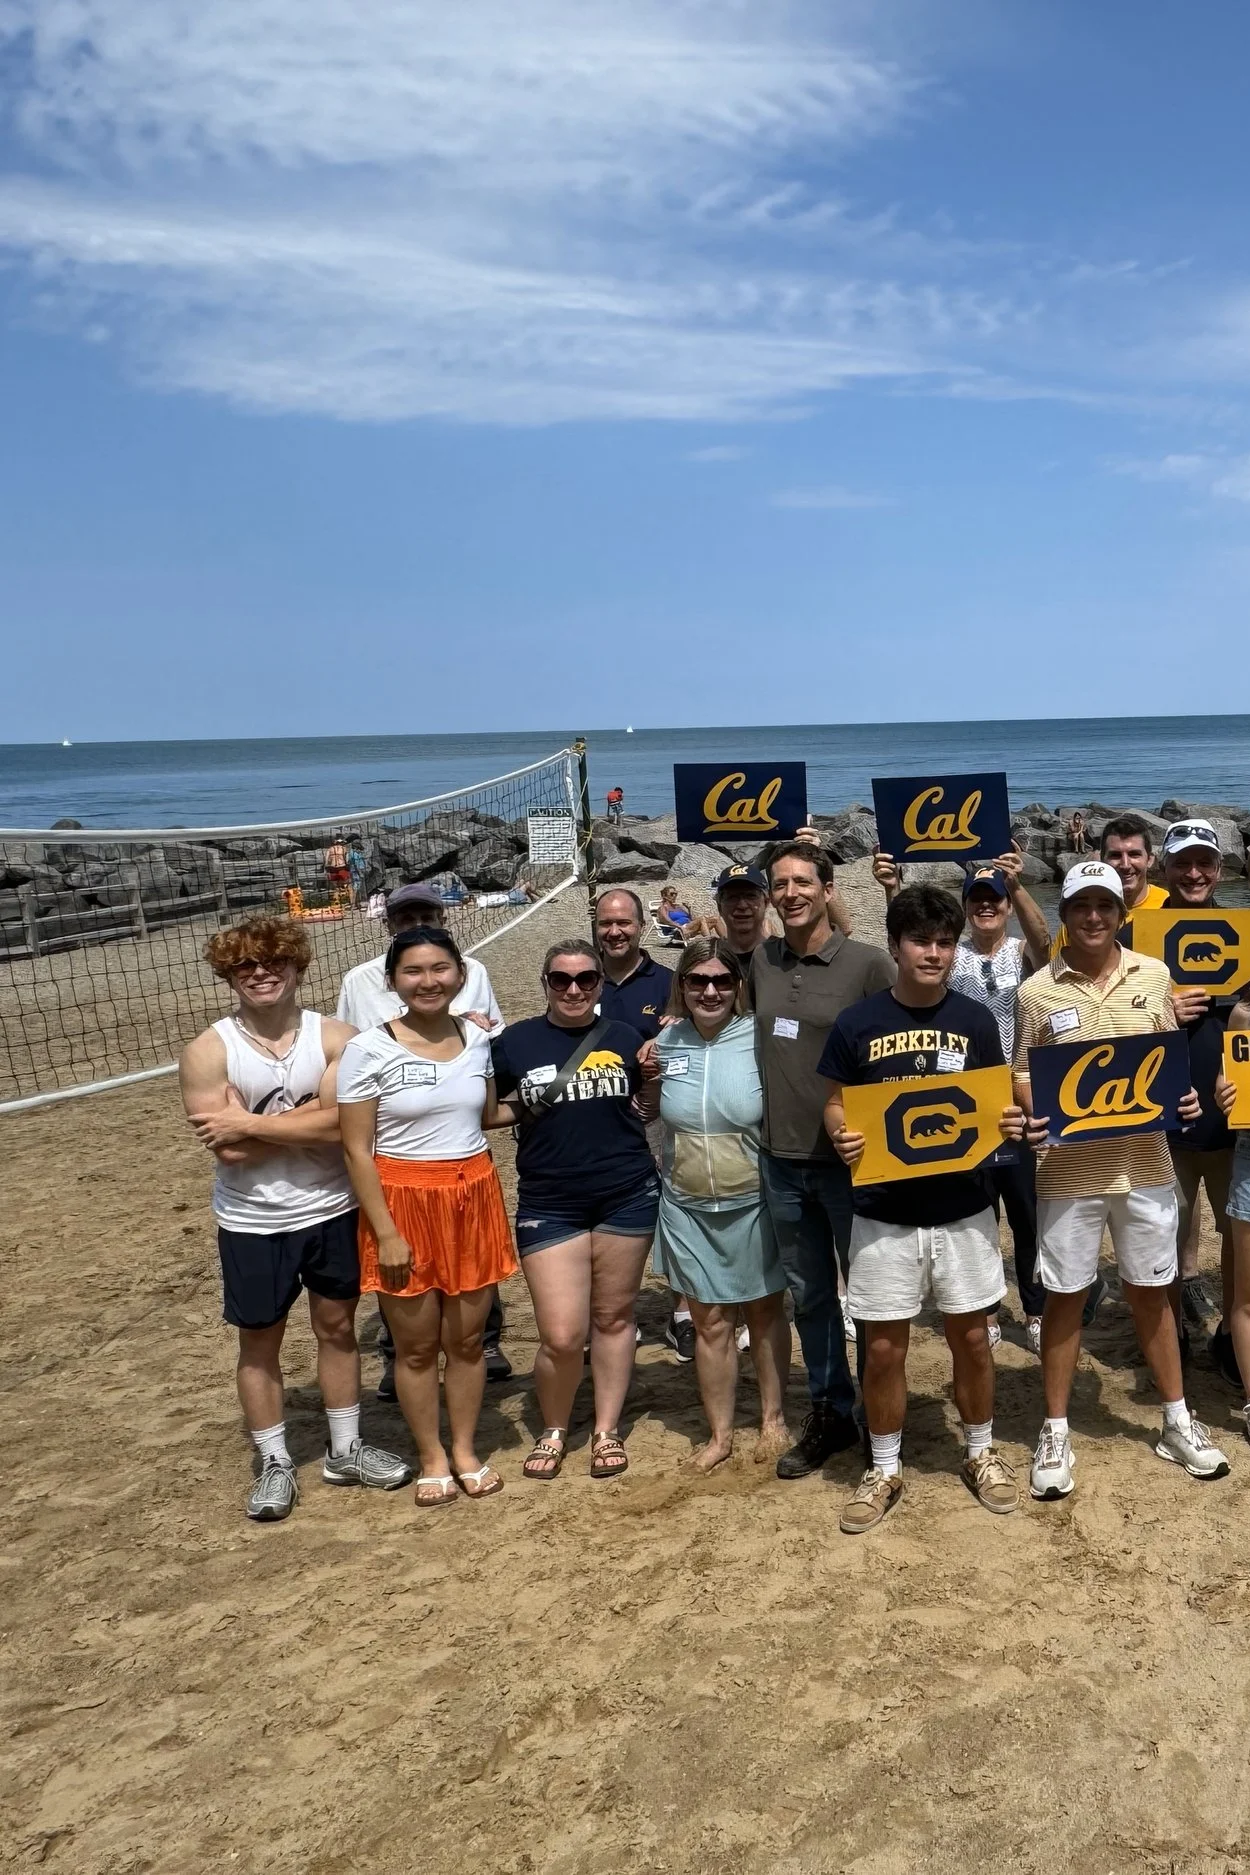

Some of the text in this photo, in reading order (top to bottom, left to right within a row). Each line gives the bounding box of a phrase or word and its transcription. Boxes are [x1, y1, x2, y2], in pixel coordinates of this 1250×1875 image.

[703, 772, 782, 834] Cal
[903, 786, 982, 854] Cal
[729, 864, 749, 877] Cal
[1080, 864, 1105, 877] Cal
[1131, 995, 1148, 1008] Cal
[868, 1030, 969, 1062] BERKELEY
[521, 1077, 630, 1107] FOTBALL
[1059, 1044, 1165, 1137] Cal
